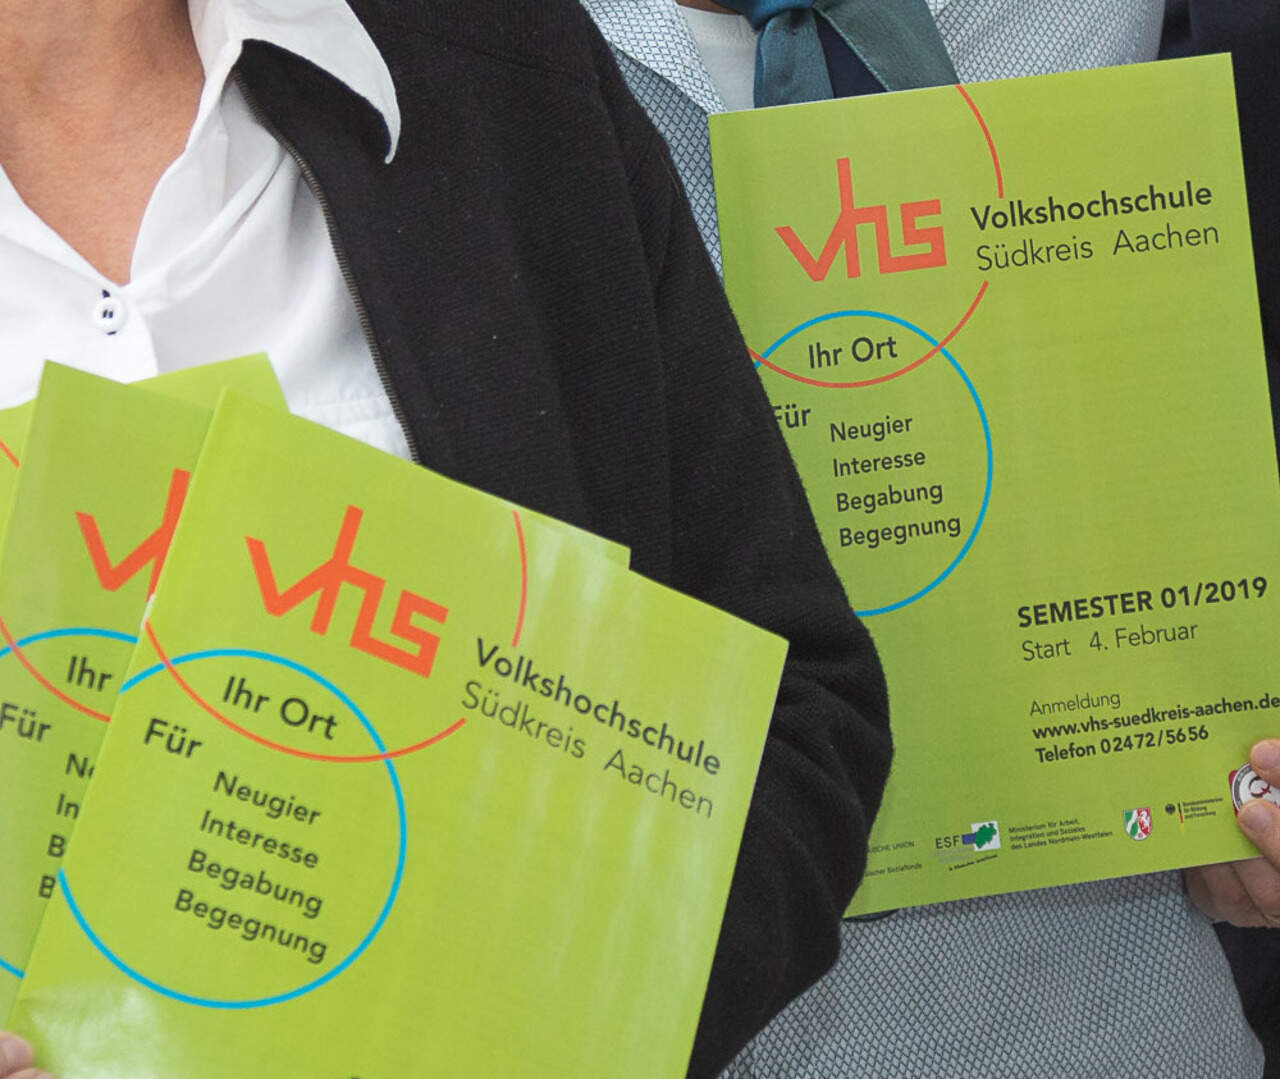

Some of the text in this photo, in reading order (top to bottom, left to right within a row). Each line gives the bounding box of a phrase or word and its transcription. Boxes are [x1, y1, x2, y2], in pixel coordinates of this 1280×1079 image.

[970, 181, 1214, 232] Volkshochschule
[975, 220, 1221, 272] Südkreis Aachen
[807, 334, 899, 370] Ihr Ort
[829, 413, 914, 446] Neugier
[832, 445, 927, 478] Interesse
[835, 481, 945, 516] Begabung
[838, 514, 962, 551] Begegnung
[1017, 576, 1268, 628] SEMESTER 01/2019
[1021, 623, 1199, 662] Start 4. Februar
[65, 654, 112, 692] Ihr
[221, 674, 339, 741] Ihr Ort
[474, 637, 721, 776] Volkshochschule
[1030, 692, 1121, 717] Anmeldung
[1032, 693, 1280, 740] www.vhs-suedkreis-aachen.de
[143, 717, 203, 760] Für
[460, 680, 715, 820] Südkreis Aachen
[1035, 742, 1097, 764] Telefon
[212, 770, 322, 827] Neugier
[199, 810, 320, 870] Interesse
[935, 835, 960, 849] ESF
[187, 849, 324, 917] Begabung
[173, 888, 329, 964] Begegnung
